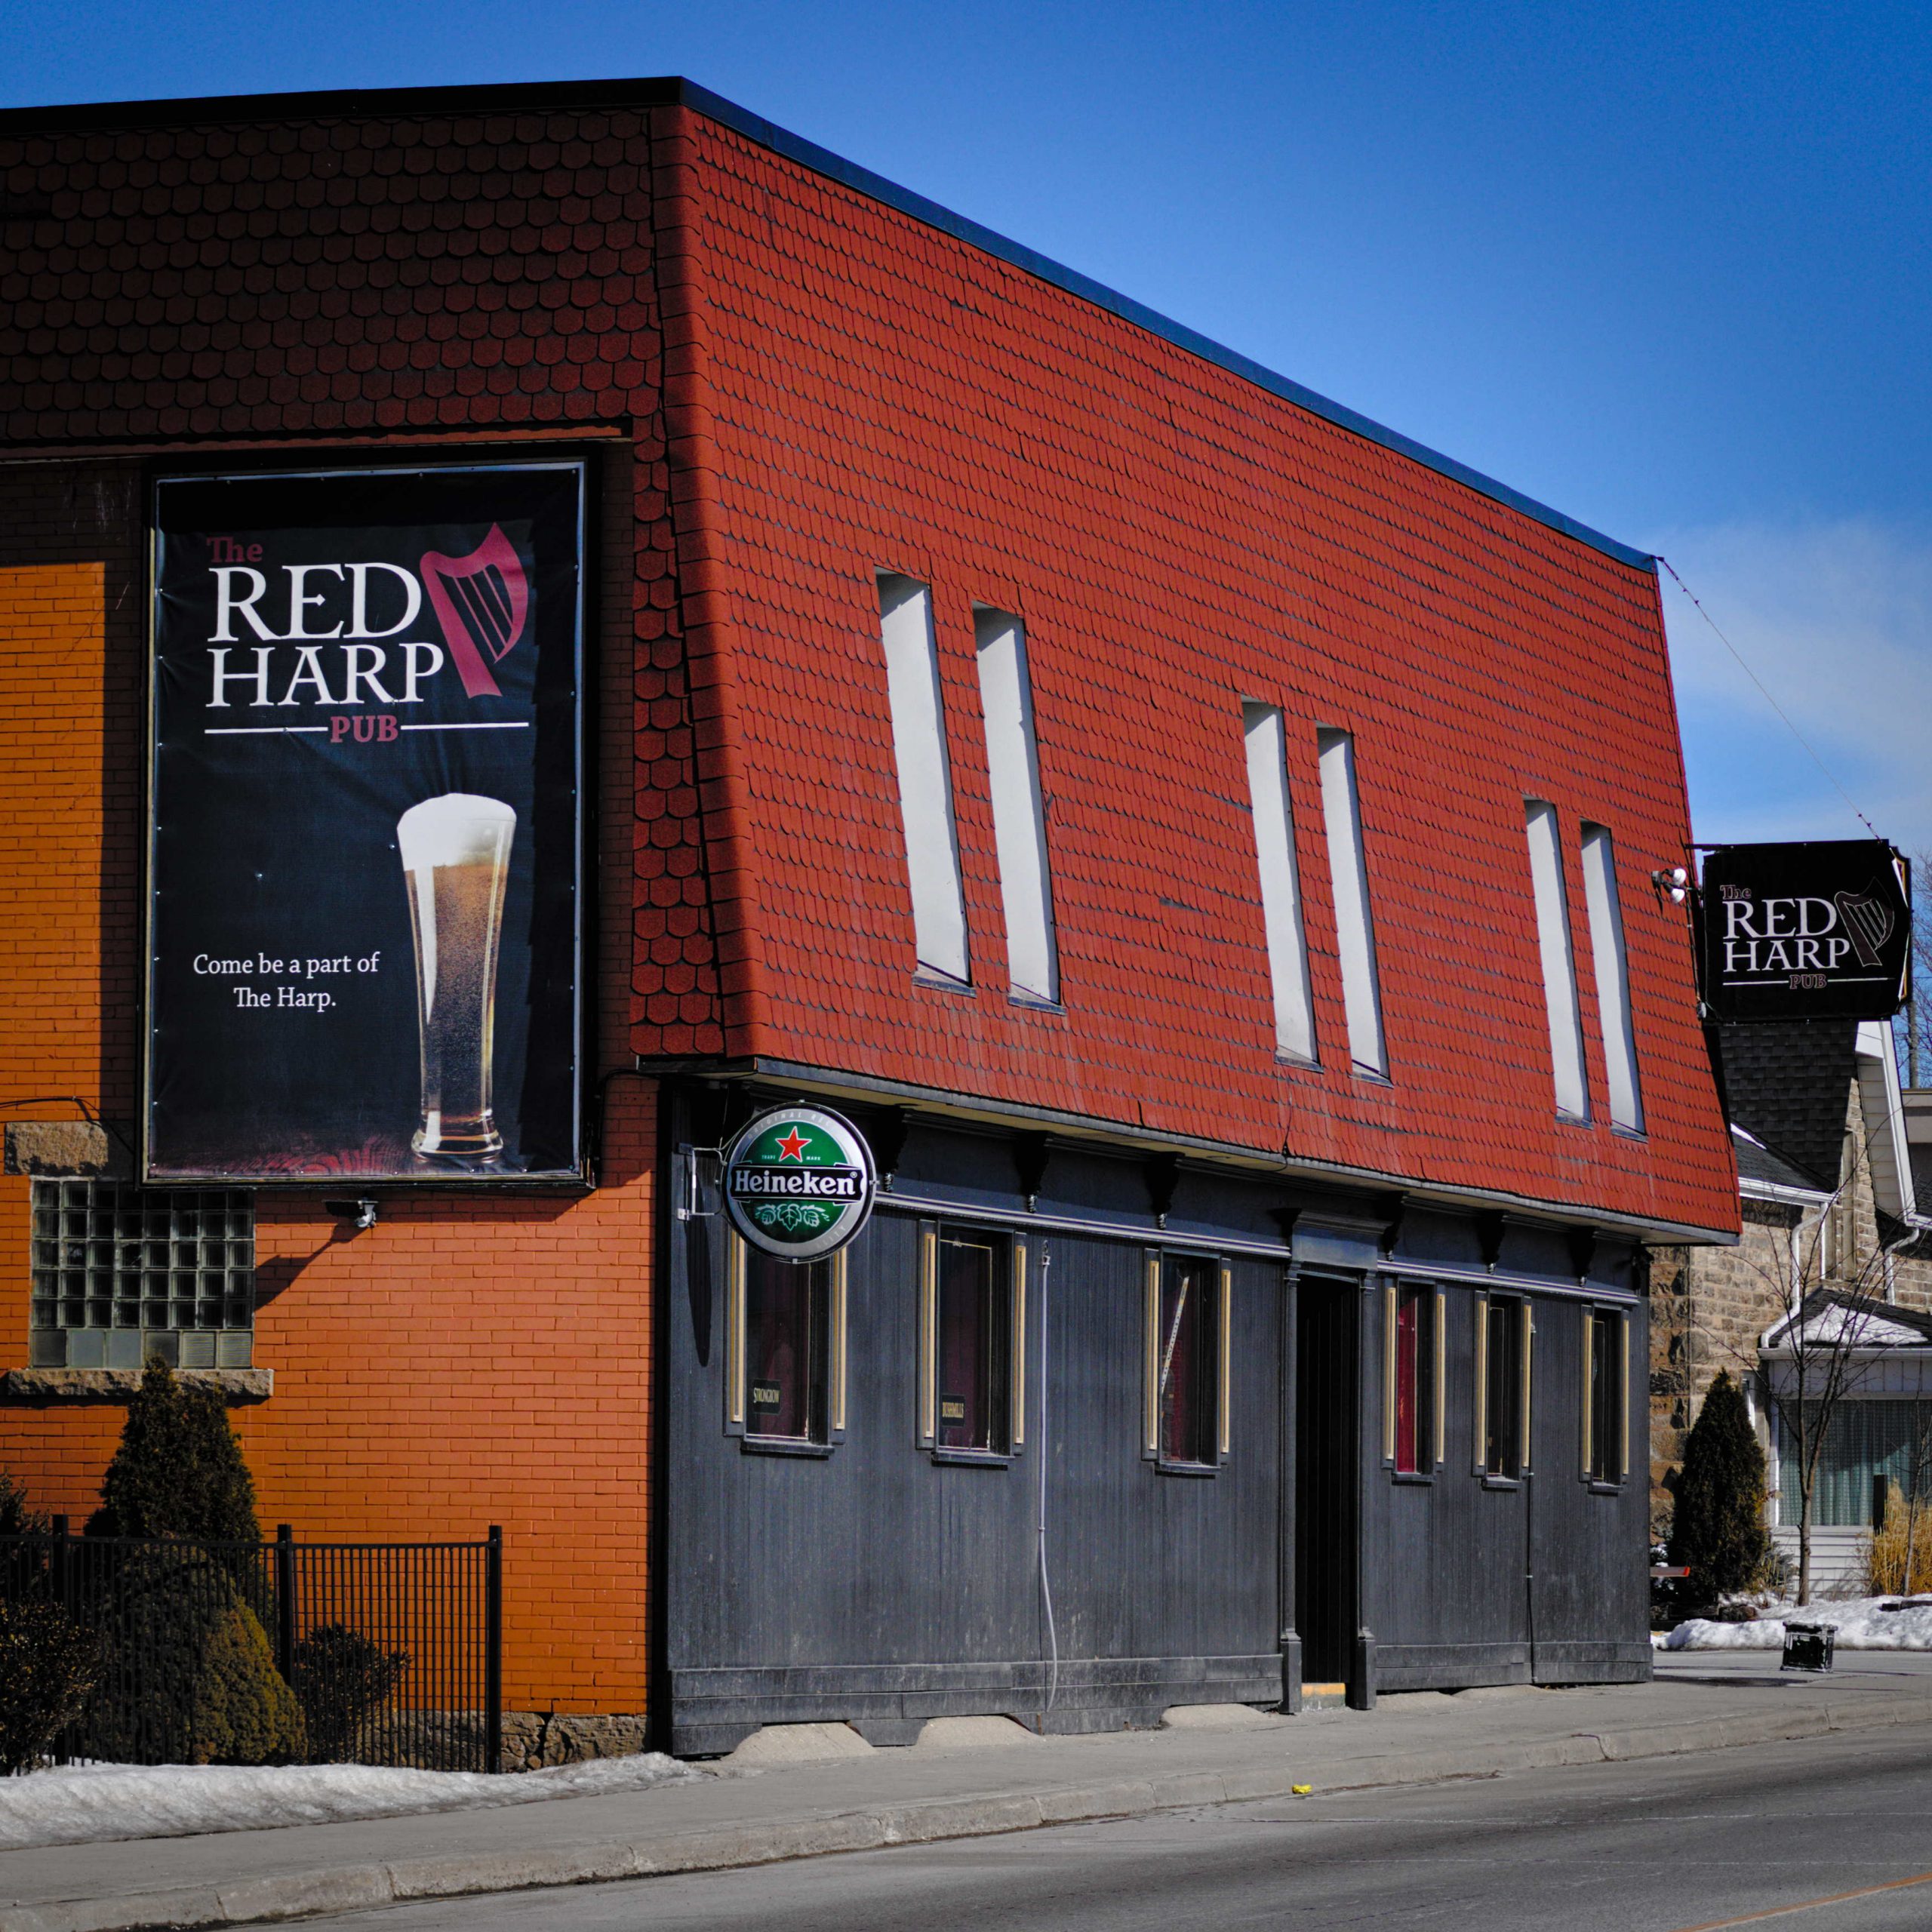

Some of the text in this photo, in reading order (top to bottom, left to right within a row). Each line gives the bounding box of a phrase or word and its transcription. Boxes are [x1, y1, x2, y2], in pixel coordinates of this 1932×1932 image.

[206, 537, 263, 563] The
[207, 561, 423, 642] RED
[205, 642, 445, 707] HARP
[330, 714, 399, 743] PUB
[1719, 884, 1752, 900] The
[1721, 897, 1838, 940] RED
[193, 951, 381, 980] Come be a part of
[1722, 938, 1850, 972] HARP
[1789, 974, 1827, 989] PUB
[233, 986, 337, 1012] The Harp.
